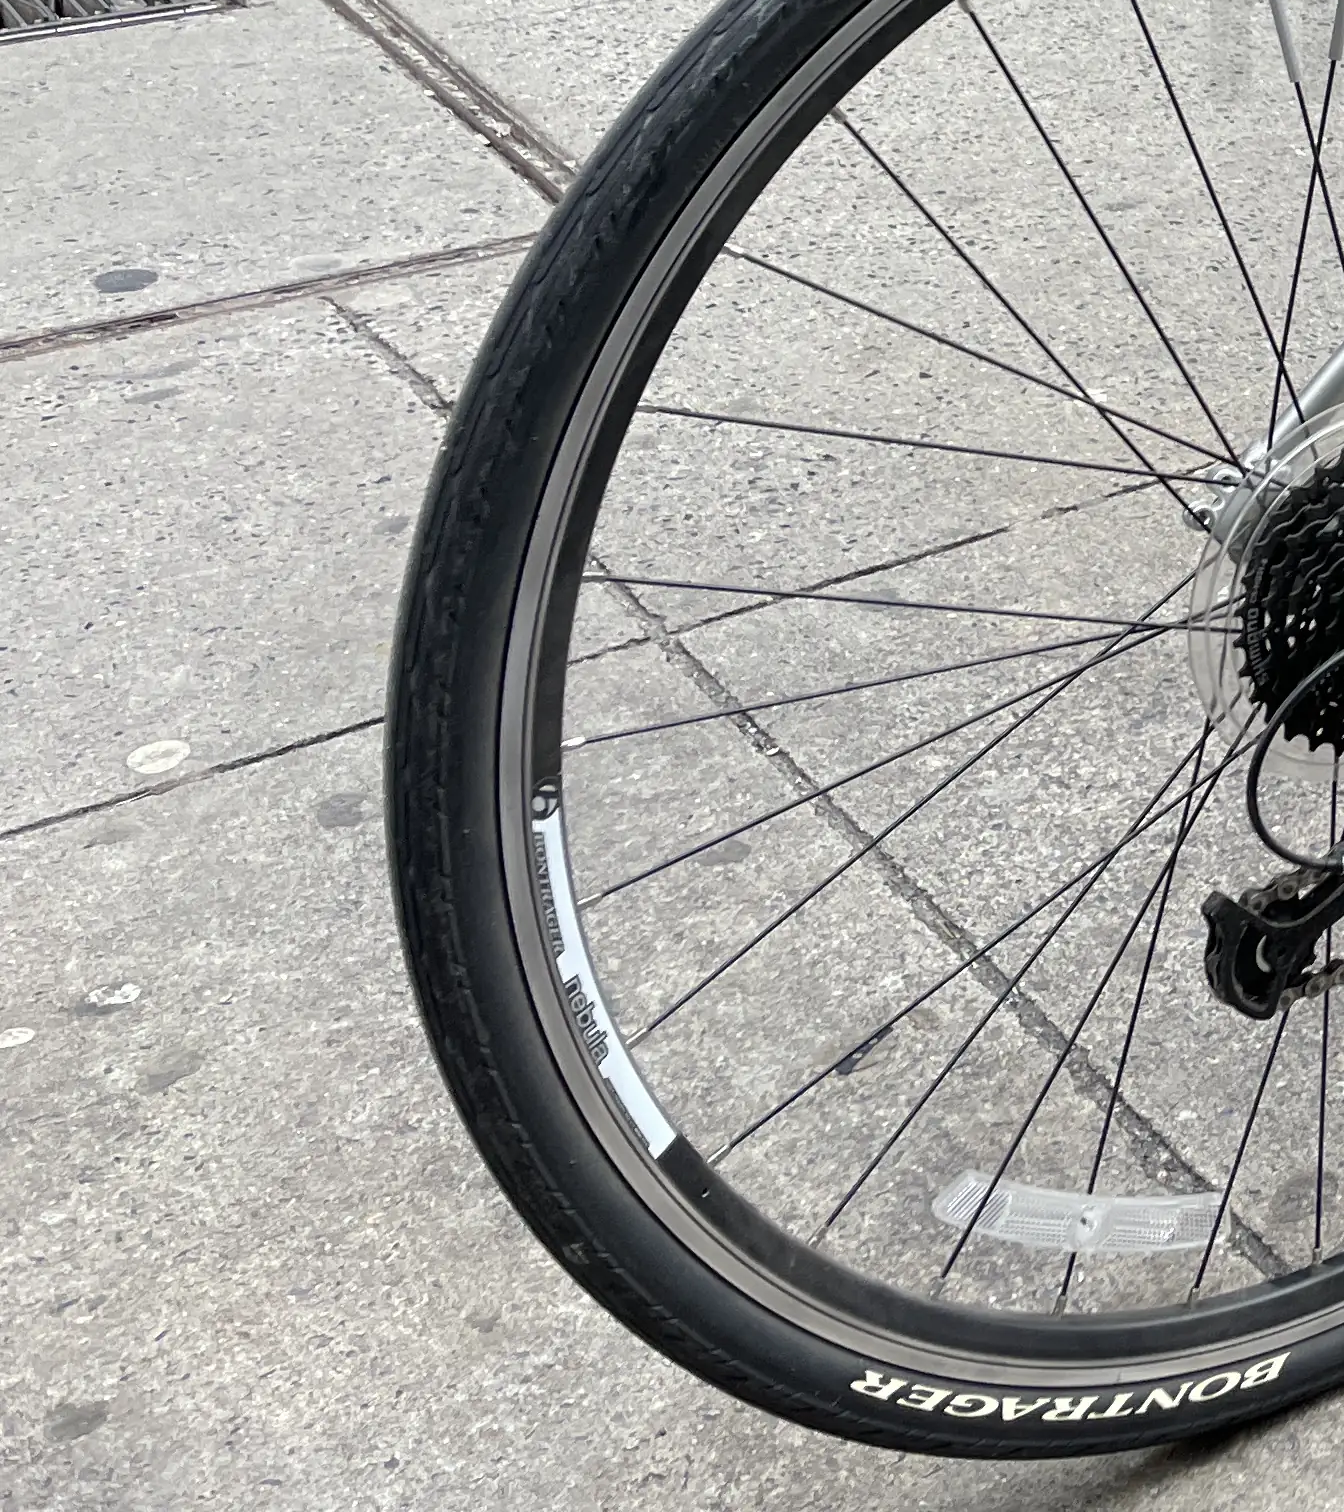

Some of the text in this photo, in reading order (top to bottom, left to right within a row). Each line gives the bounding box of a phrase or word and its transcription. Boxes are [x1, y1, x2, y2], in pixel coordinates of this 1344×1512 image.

[534, 831, 610, 1066] BONTRAGER nebula
[849, 1351, 1292, 1423] BONTRAGER
